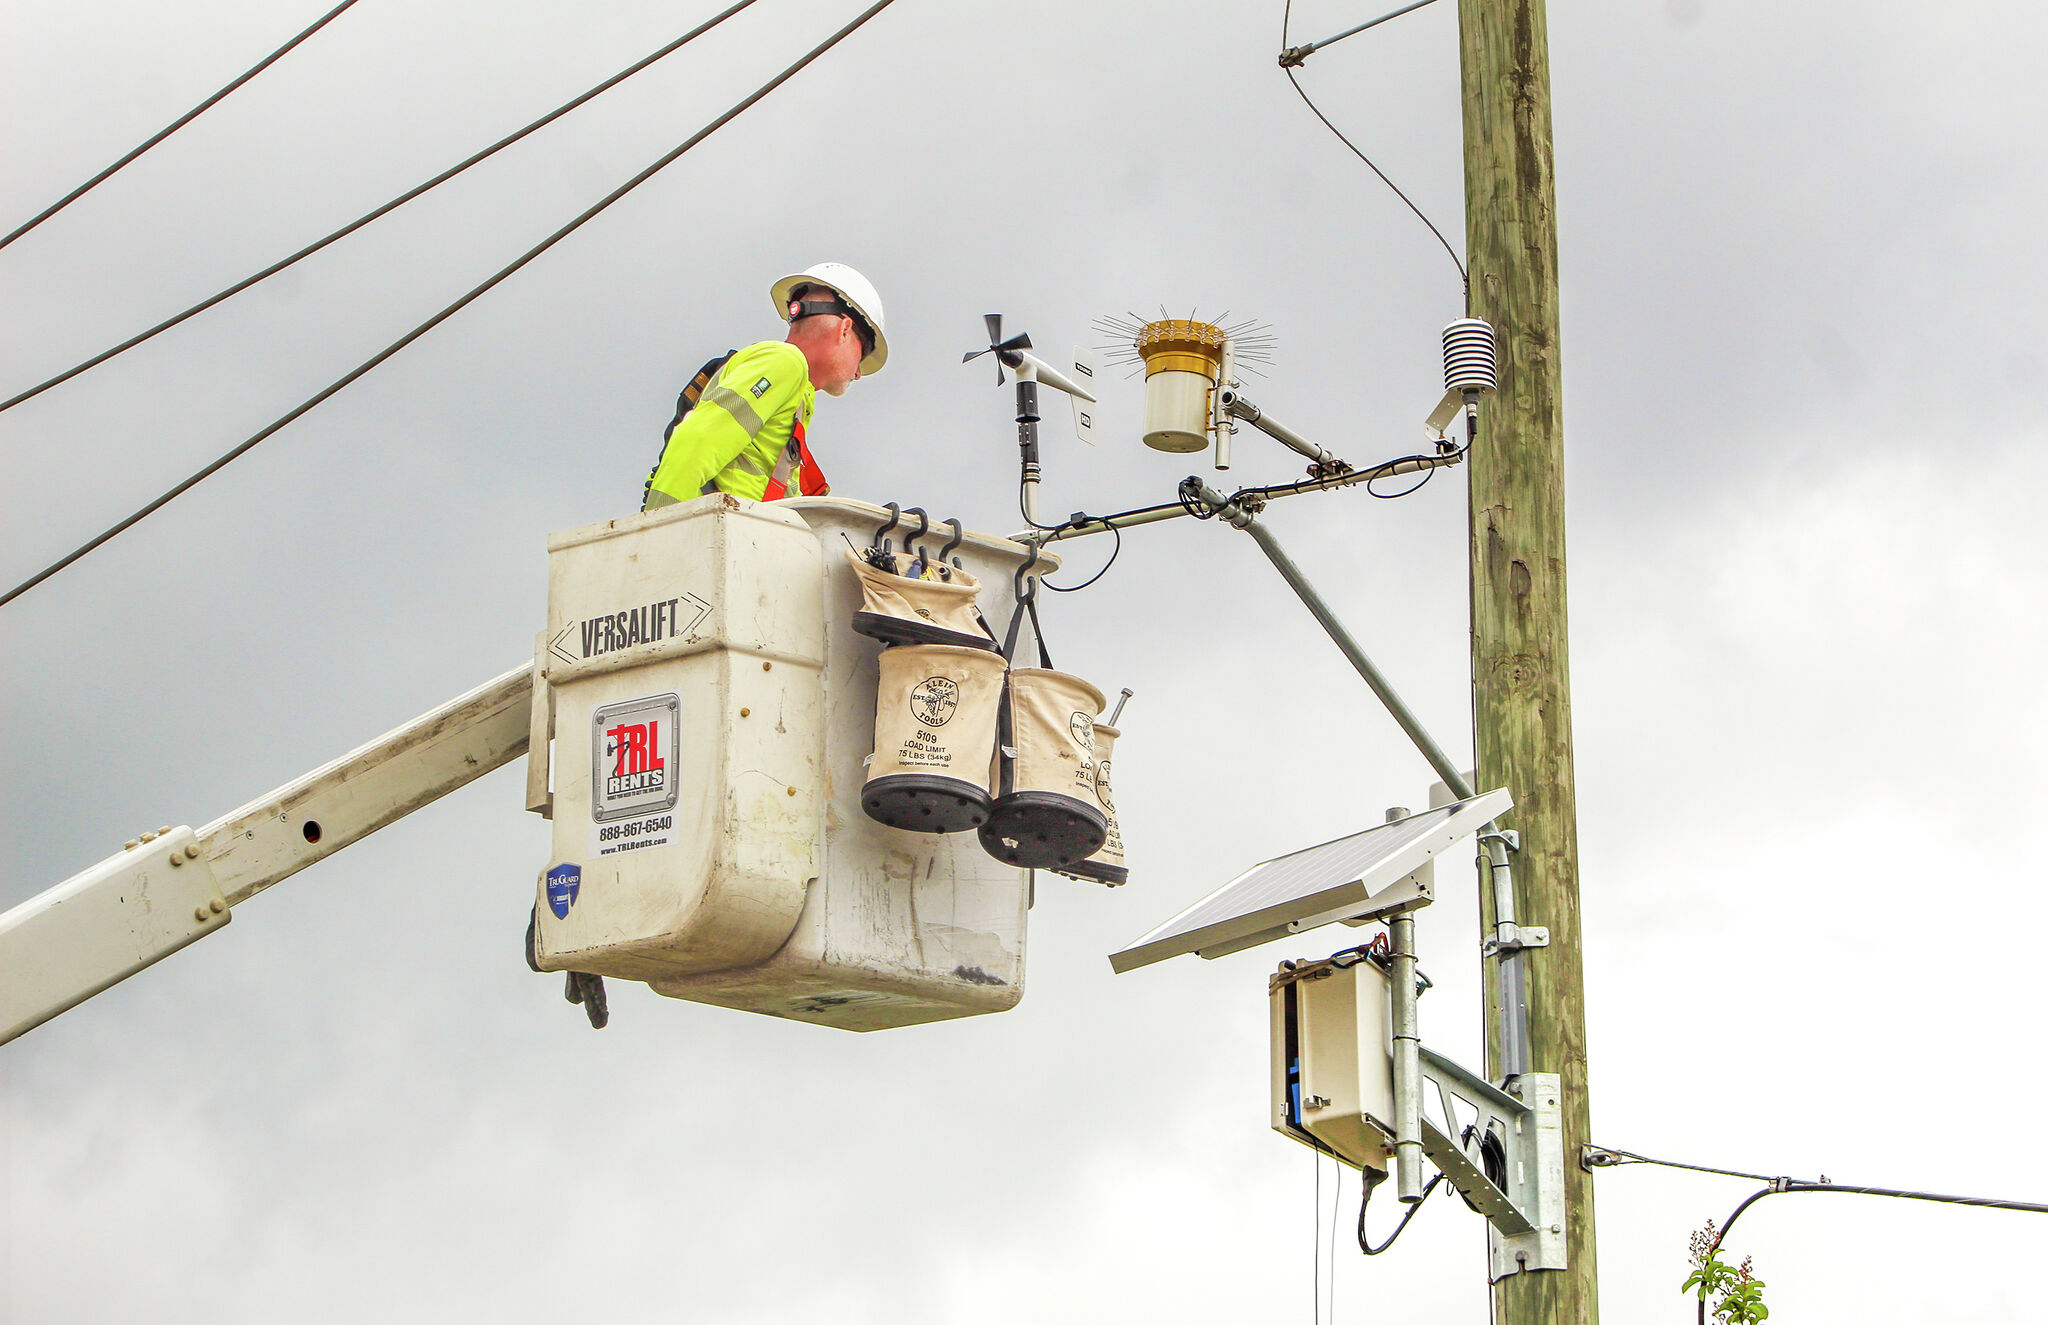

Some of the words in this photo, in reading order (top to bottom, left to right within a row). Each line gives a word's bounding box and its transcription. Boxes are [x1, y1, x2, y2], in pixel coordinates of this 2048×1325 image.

[581, 598, 679, 658] VERSALIFT
[925, 680, 954, 690] KLEIN
[919, 711, 944, 725] TOOLS
[916, 729, 937, 744] 5109
[607, 721, 664, 777] TRL
[904, 740, 924, 750] LOAD
[925, 744, 946, 753] LIMIT
[898, 749, 907, 757] 75
[909, 751, 925, 759] LBS
[927, 753, 952, 762] (34kg)
[608, 769, 664, 794] RENTS
[1075, 770, 1085, 778] 75
[600, 816, 672, 841] 888-867-6540
[601, 838, 667, 855] www.TRLRents.com
